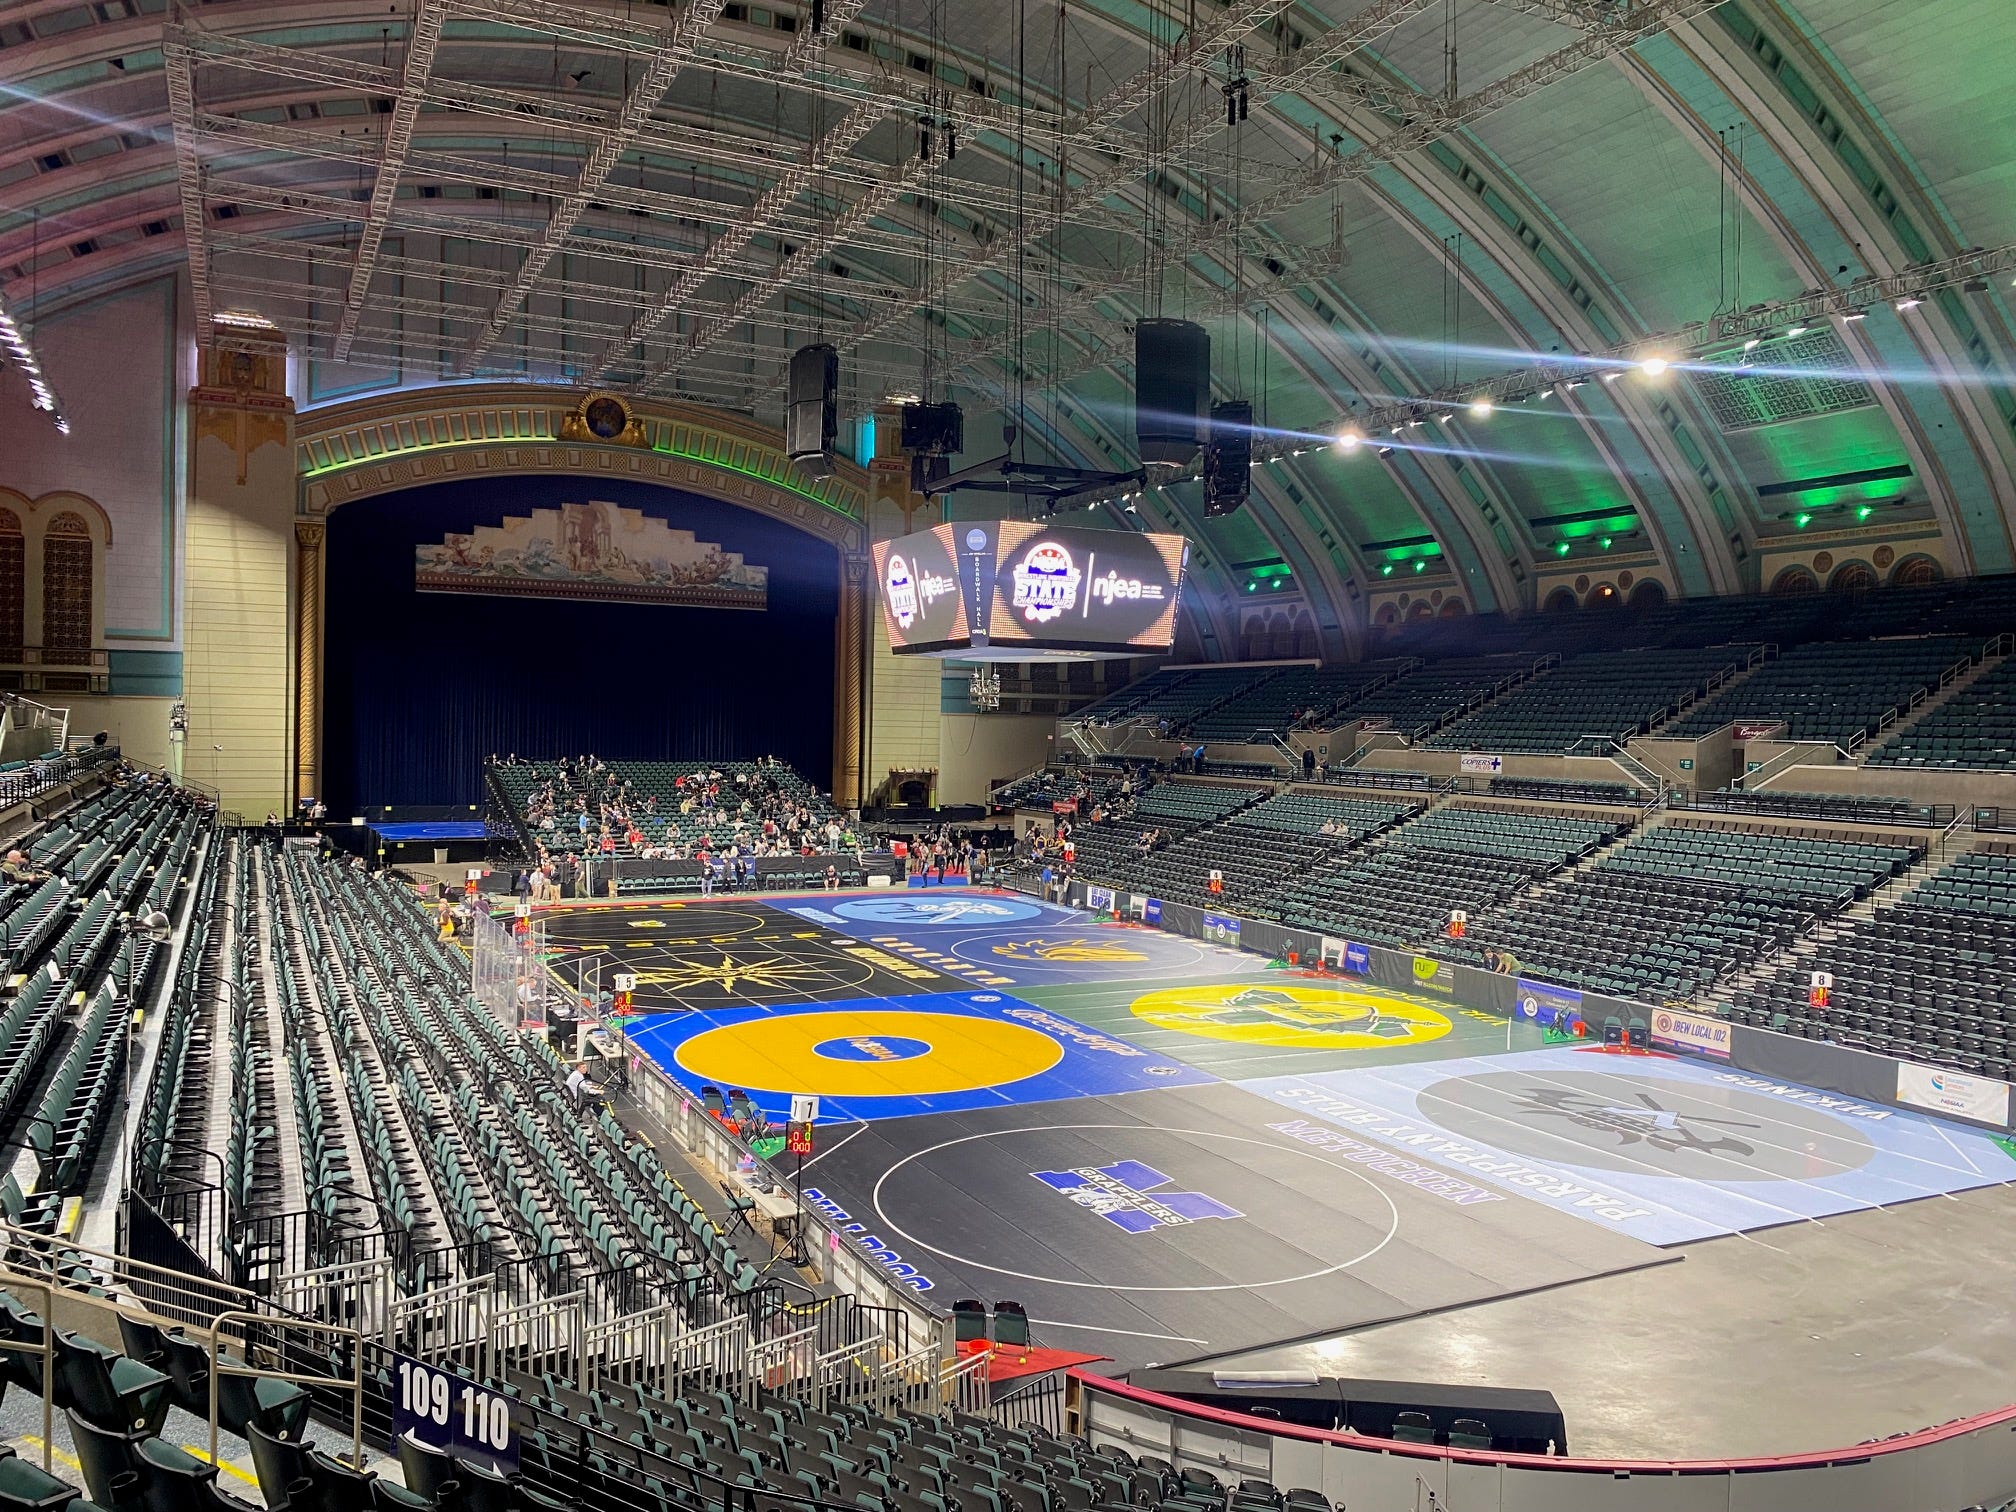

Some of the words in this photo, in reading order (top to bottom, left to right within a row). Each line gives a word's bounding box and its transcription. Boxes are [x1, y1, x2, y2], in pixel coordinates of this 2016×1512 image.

[1015, 579, 1076, 600] STATE
[1093, 570, 1142, 605] njea
[1462, 759, 1491, 767] COPIERS
[1818, 974, 1825, 986] 8
[1673, 1020, 1692, 1035] IBEW
[1691, 1023, 1712, 1040] LOCAL
[1713, 1029, 1727, 1042] 102
[1275, 1088, 1391, 1125] HILLS
[1712, 1074, 1895, 1121] VIKINGS
[1264, 1119, 1508, 1206] METUCHEN
[1369, 1125, 1655, 1221] PARSIPPANY
[1078, 1169, 1185, 1224] GRAPPLERS
[399, 1361, 449, 1426] 109
[461, 1385, 509, 1451] 110
